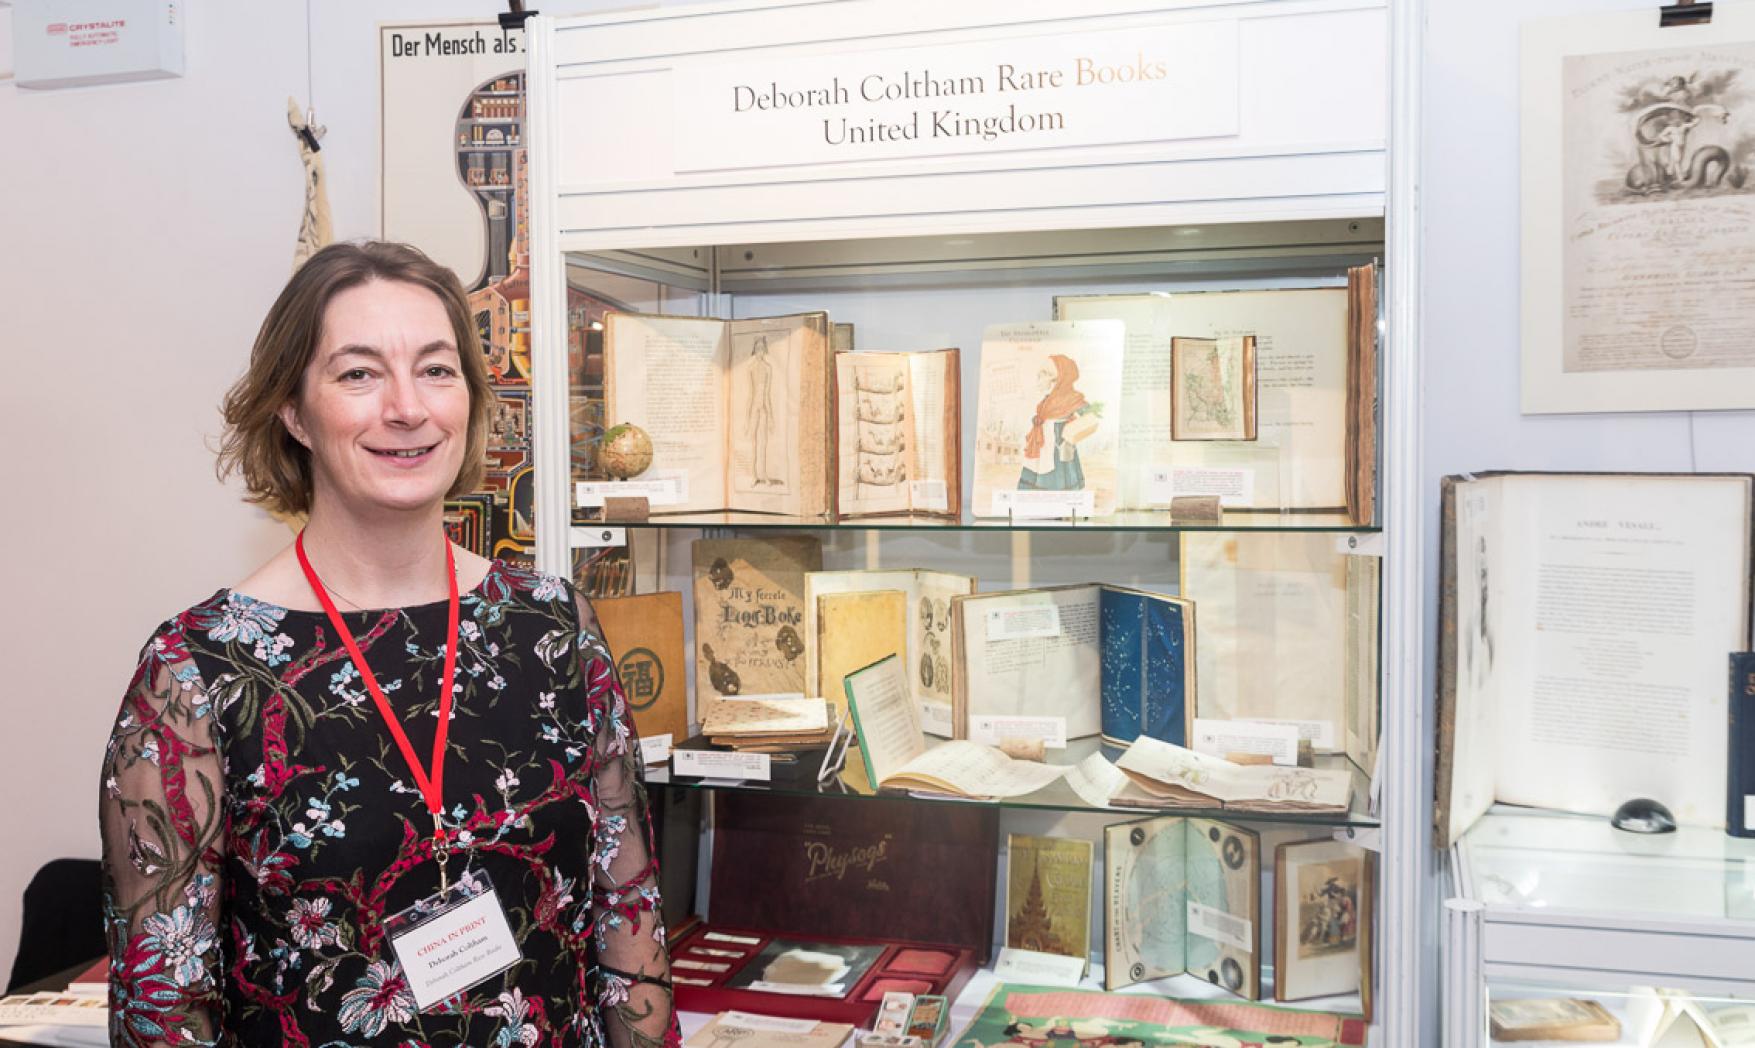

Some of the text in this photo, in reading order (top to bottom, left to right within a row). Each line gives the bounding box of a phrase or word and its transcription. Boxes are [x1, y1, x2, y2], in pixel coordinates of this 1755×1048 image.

[69, 20, 125, 32] CRYSTALITE
[392, 33, 421, 57] Der
[425, 30, 486, 57] Mensch
[493, 28, 517, 54] als
[733, 50, 1168, 113] Deborah Coltham Rare Books
[823, 104, 1065, 146] United Kingdom
[416, 917, 487, 957] CHINA IN PRINT
